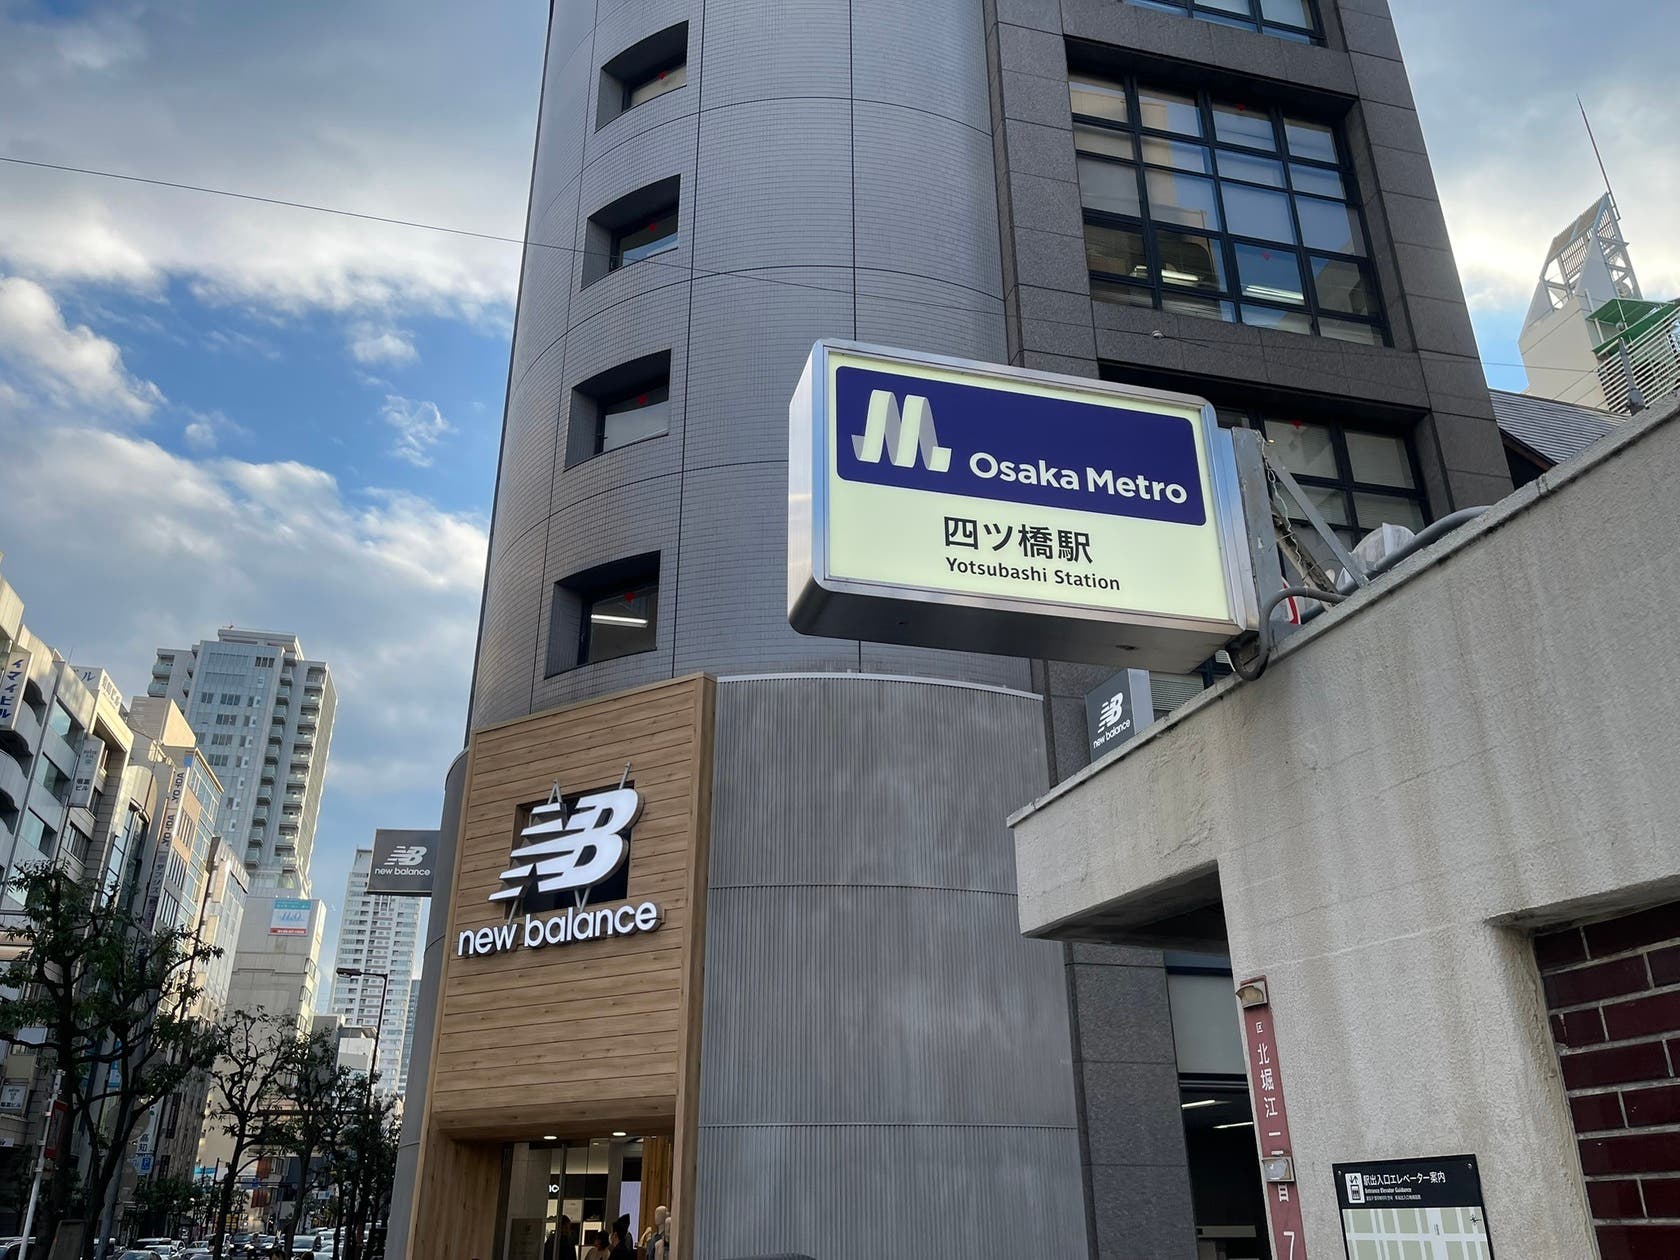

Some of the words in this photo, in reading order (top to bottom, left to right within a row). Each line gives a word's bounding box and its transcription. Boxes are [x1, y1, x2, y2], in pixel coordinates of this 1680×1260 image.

[969, 452, 1079, 491] Osaka
[1088, 466, 1187, 504] Metro
[944, 516, 1092, 563] 四ツ橋駅
[946, 557, 1048, 583] Yotsubashi
[1055, 569, 1120, 591] Station
[1093, 736, 1105, 749] new
[1105, 719, 1131, 741] balance
[394, 867, 431, 876] balance
[458, 924, 517, 956] new
[524, 902, 658, 947] balance
[1363, 1171, 1446, 1186] 駅出入口エレベーター案内
